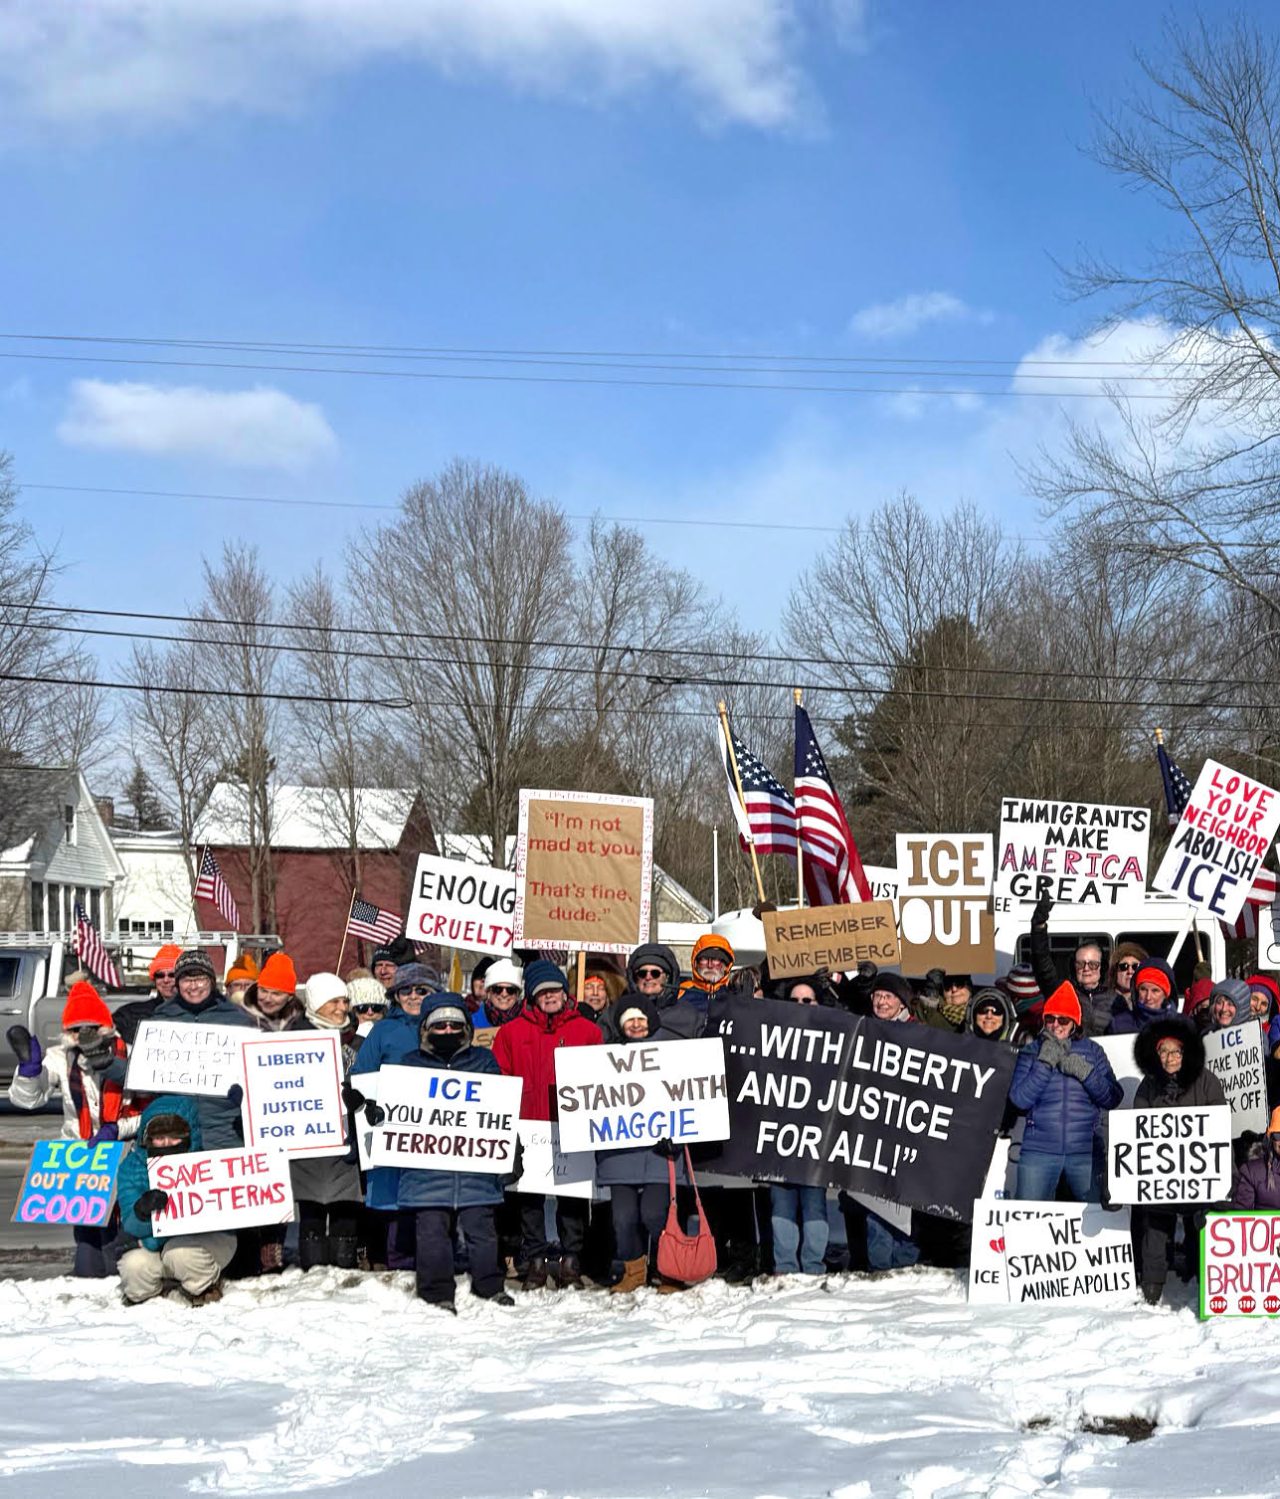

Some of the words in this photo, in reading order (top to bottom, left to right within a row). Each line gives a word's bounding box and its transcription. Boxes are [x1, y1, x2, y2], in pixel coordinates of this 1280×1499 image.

[1210, 768, 1275, 812] LOVE
[590, 817, 622, 832] not
[1002, 801, 1148, 832] IMMIGRANTS
[1208, 789, 1265, 833] YOUR
[1045, 827, 1109, 851] MAKE
[1183, 805, 1268, 859] NEIGHBOR
[529, 838, 571, 852] mad
[576, 840, 596, 855] at
[599, 843, 641, 857] you.
[1000, 843, 1144, 882] AMERICA
[1175, 827, 1260, 881] ABOLISH
[906, 839, 985, 887] ICE
[418, 870, 517, 914] ENOUG
[1009, 873, 1129, 905] GREAT
[1171, 856, 1239, 917] ICE
[774, 915, 891, 943] REMEMBER
[901, 897, 988, 946] OUT
[771, 942, 897, 971] NUREMBERG
[1221, 1029, 1244, 1050] ICE
[257, 1051, 326, 1067] LIBERTY
[606, 1047, 661, 1074] WE
[852, 1035, 996, 1099] LIBERTY
[1207, 1053, 1232, 1074] TAKE
[1234, 1045, 1260, 1070] YOUR
[273, 1076, 305, 1090] and
[428, 1077, 483, 1103] ICE
[558, 1082, 646, 1112] STAND
[661, 1073, 728, 1102] WITH
[262, 1099, 325, 1116] JUSTICE
[736, 1070, 812, 1110] AND
[816, 1079, 954, 1141] JUSTICE
[1240, 1089, 1262, 1111] OFF
[259, 1126, 296, 1139] FOR
[304, 1121, 336, 1136] ALL
[384, 1102, 424, 1124] YOU
[428, 1108, 468, 1128] ARE
[476, 1111, 513, 1131] THE
[589, 1108, 699, 1144] MAGGIE
[1135, 1113, 1210, 1139] RESIST
[42, 1141, 109, 1171] ICE
[382, 1131, 512, 1161] TERRORISTS
[755, 1119, 823, 1160] FOR
[827, 1130, 918, 1177] ALL!"
[1113, 1141, 1230, 1178] RESIST
[30, 1172, 70, 1189] OUT
[75, 1173, 111, 1191] FOR
[156, 1158, 213, 1191] SAVE
[220, 1152, 271, 1179] THE
[154, 1182, 287, 1222] MID-TERMS
[1137, 1177, 1221, 1200] RESIST
[20, 1194, 108, 1225] GOOD
[1048, 1216, 1082, 1246] WE
[1007, 1250, 1077, 1278] STAND
[1085, 1242, 1133, 1268] WITH
[974, 1269, 1000, 1285] ICE
[1020, 1271, 1131, 1303] MINNEAPOLIS
[1210, 1300, 1228, 1309] STOP
[1238, 1300, 1257, 1309] STOP
[1263, 1299, 1280, 1309] STOP
